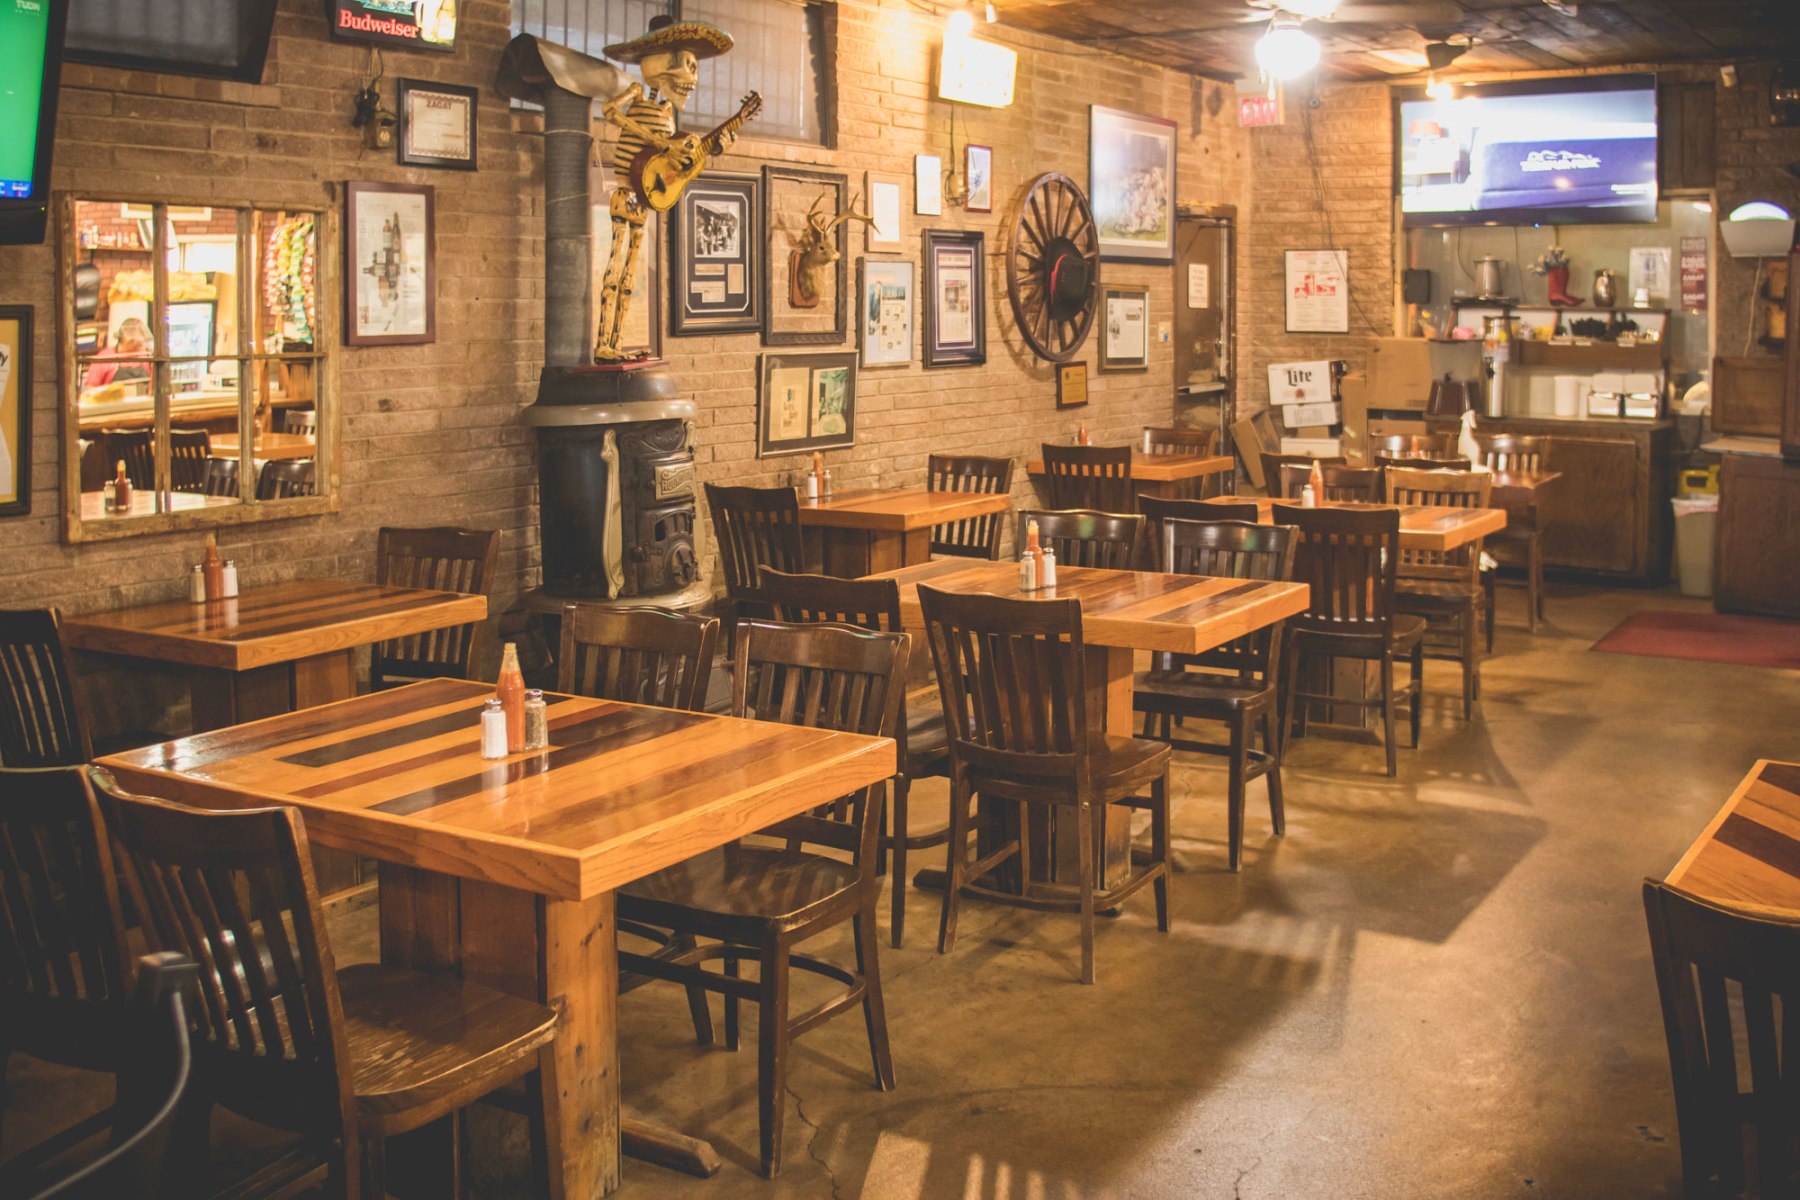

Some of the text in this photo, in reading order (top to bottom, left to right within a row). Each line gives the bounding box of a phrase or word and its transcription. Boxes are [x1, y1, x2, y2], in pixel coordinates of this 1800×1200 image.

[339, 9, 418, 38] Budweiser
[426, 99, 452, 110] ZAGAT
[1287, 370, 1312, 387] Lite
